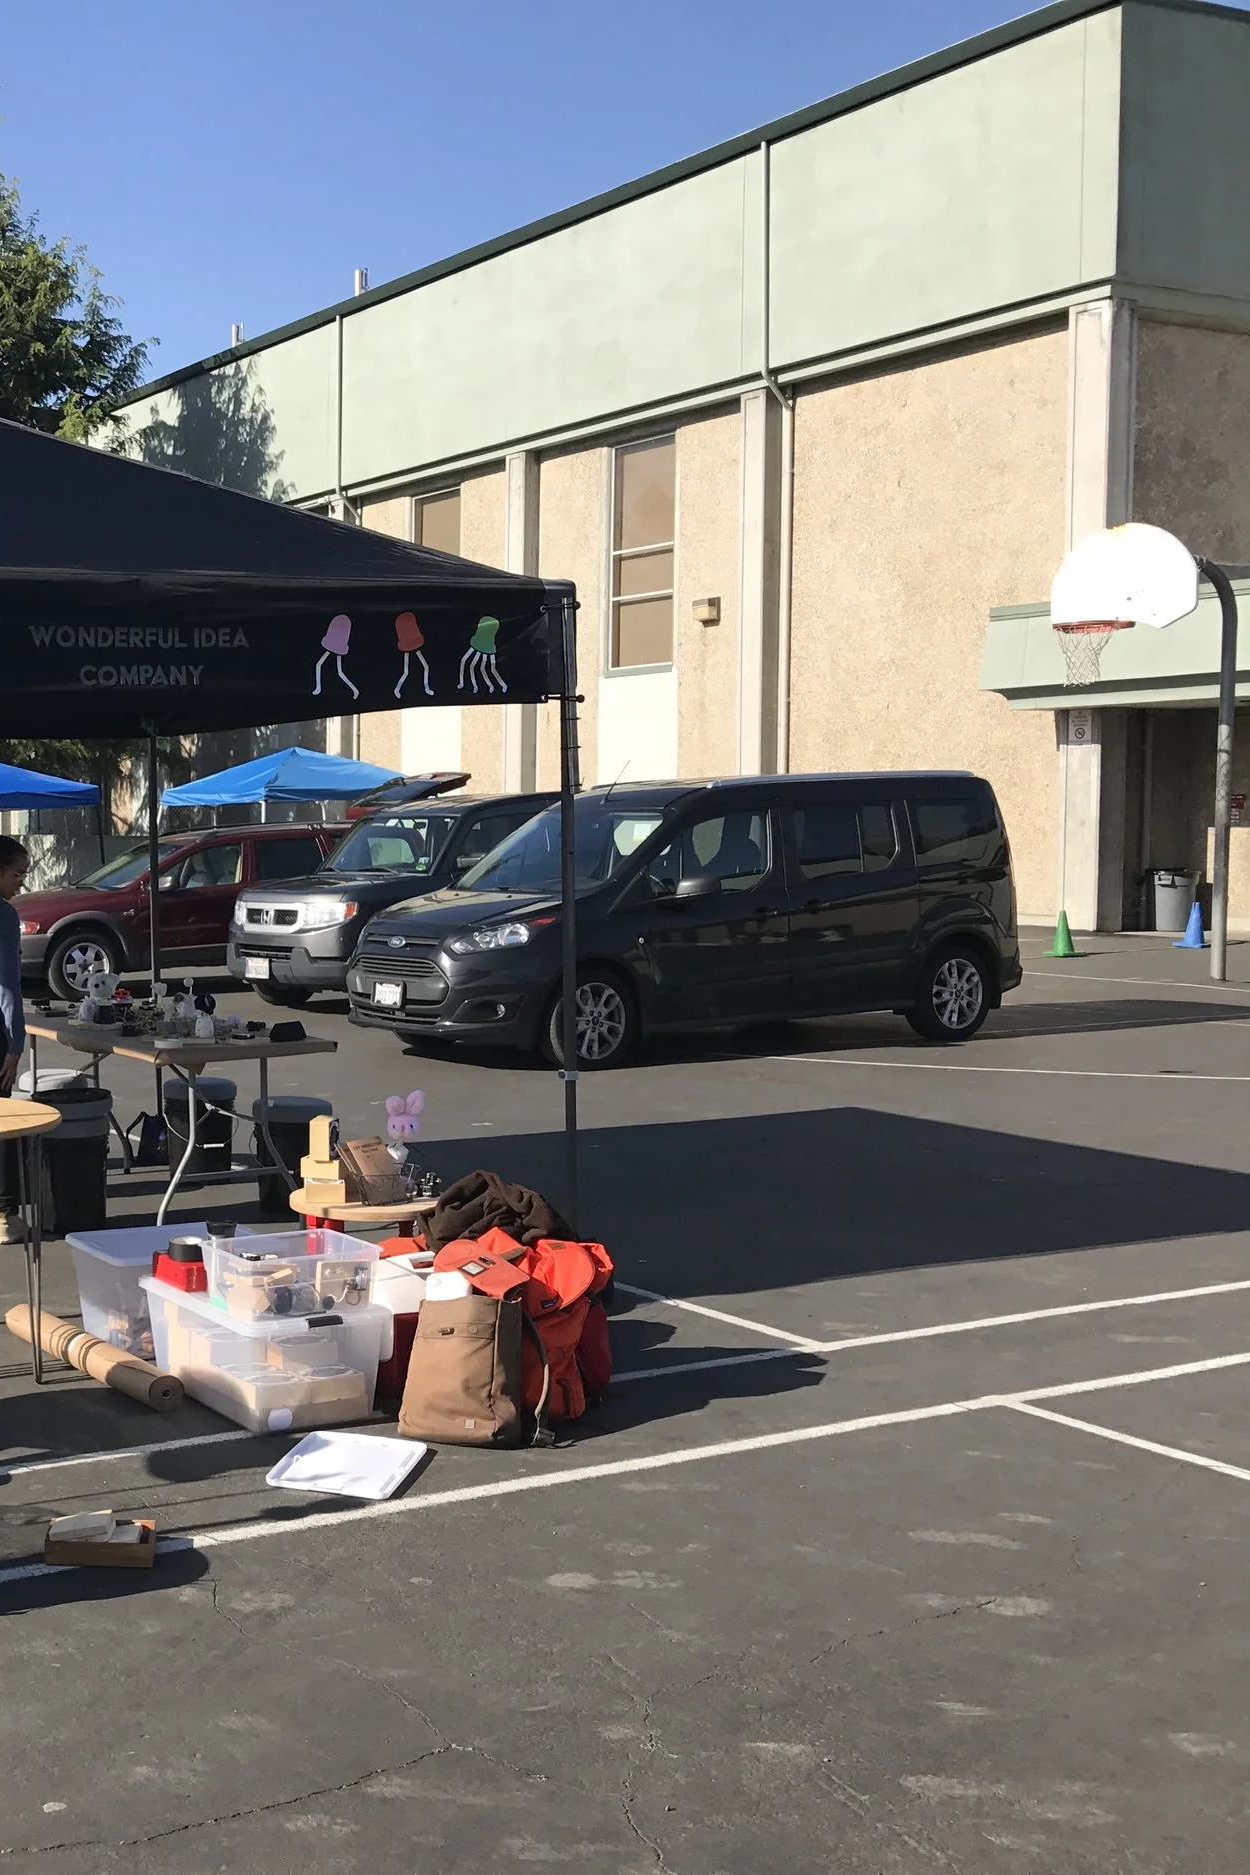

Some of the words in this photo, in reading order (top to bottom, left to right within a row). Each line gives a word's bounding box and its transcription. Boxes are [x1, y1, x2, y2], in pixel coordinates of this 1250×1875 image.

[28, 625, 188, 649] WONDERFUL
[193, 627, 250, 649] IDEA
[79, 664, 205, 687] COMPANY
